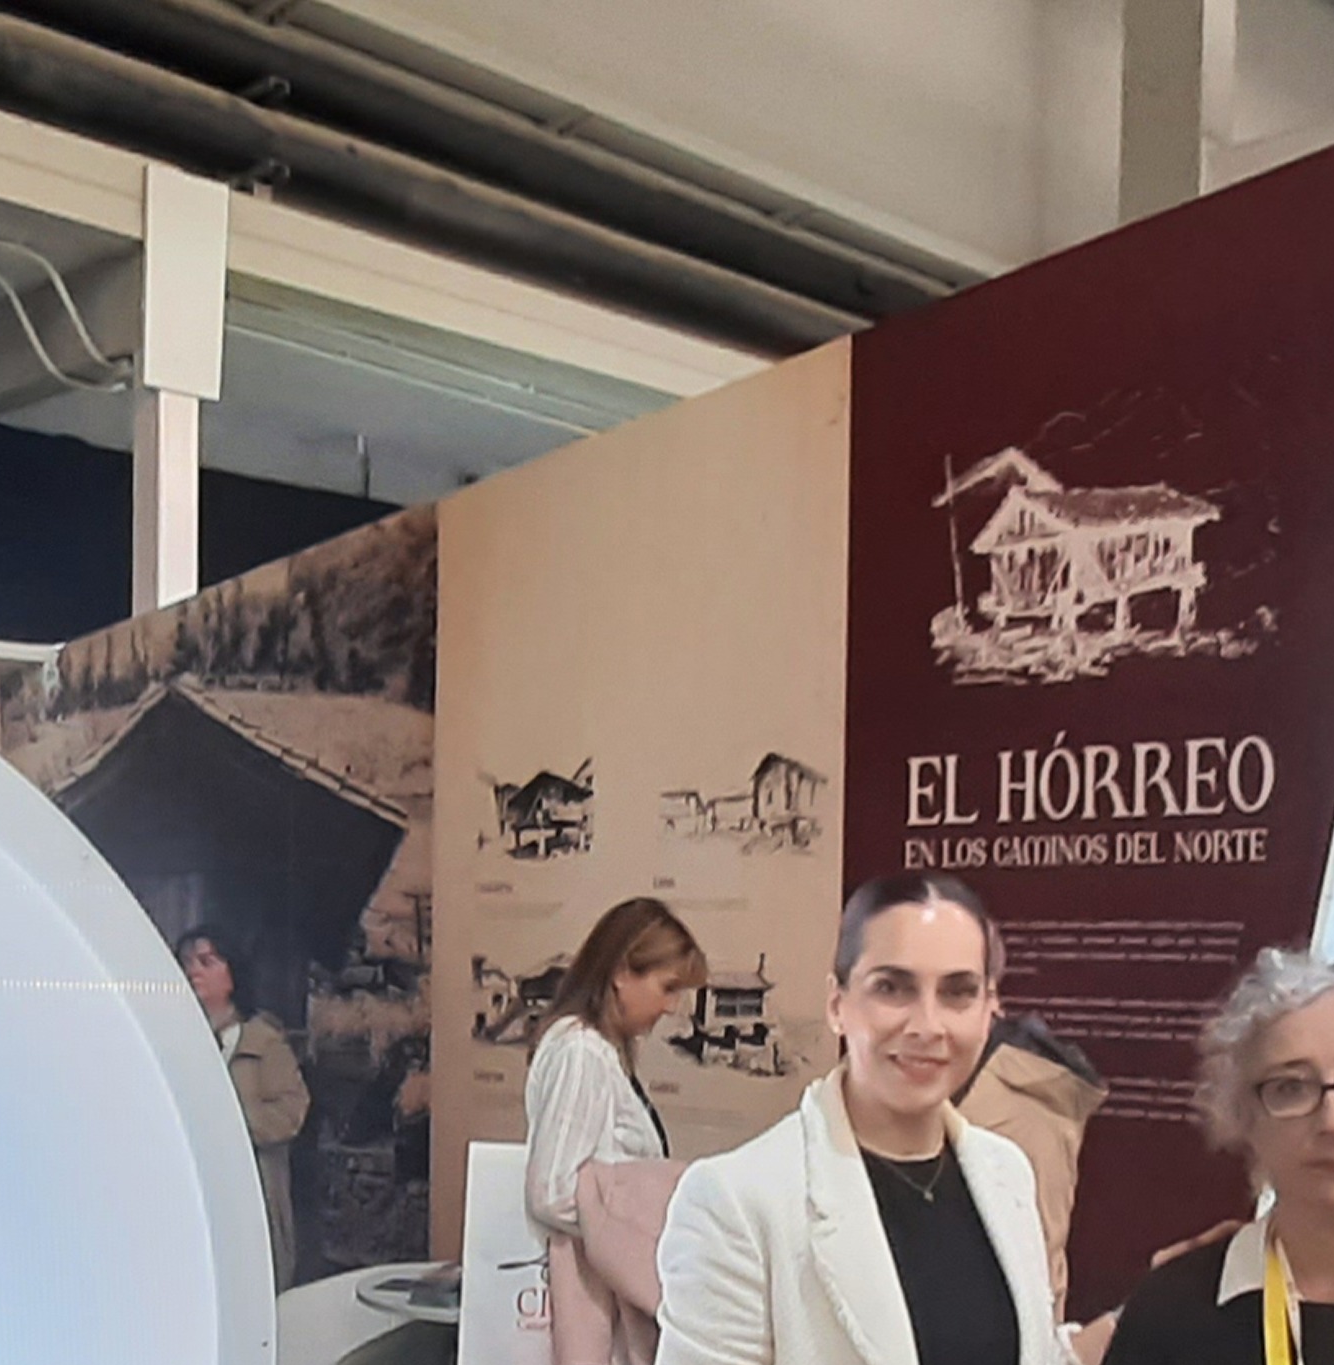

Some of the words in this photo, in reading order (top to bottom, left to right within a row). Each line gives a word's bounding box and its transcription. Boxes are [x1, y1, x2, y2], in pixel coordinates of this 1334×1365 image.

[906, 754, 979, 827] EL
[996, 730, 1276, 823] HÓRREO
[904, 840, 936, 869] EN
[941, 837, 987, 869] LOS
[992, 834, 1108, 867] CAMINOS
[1114, 831, 1167, 865] DEL
[1174, 828, 1268, 863] NORTE
